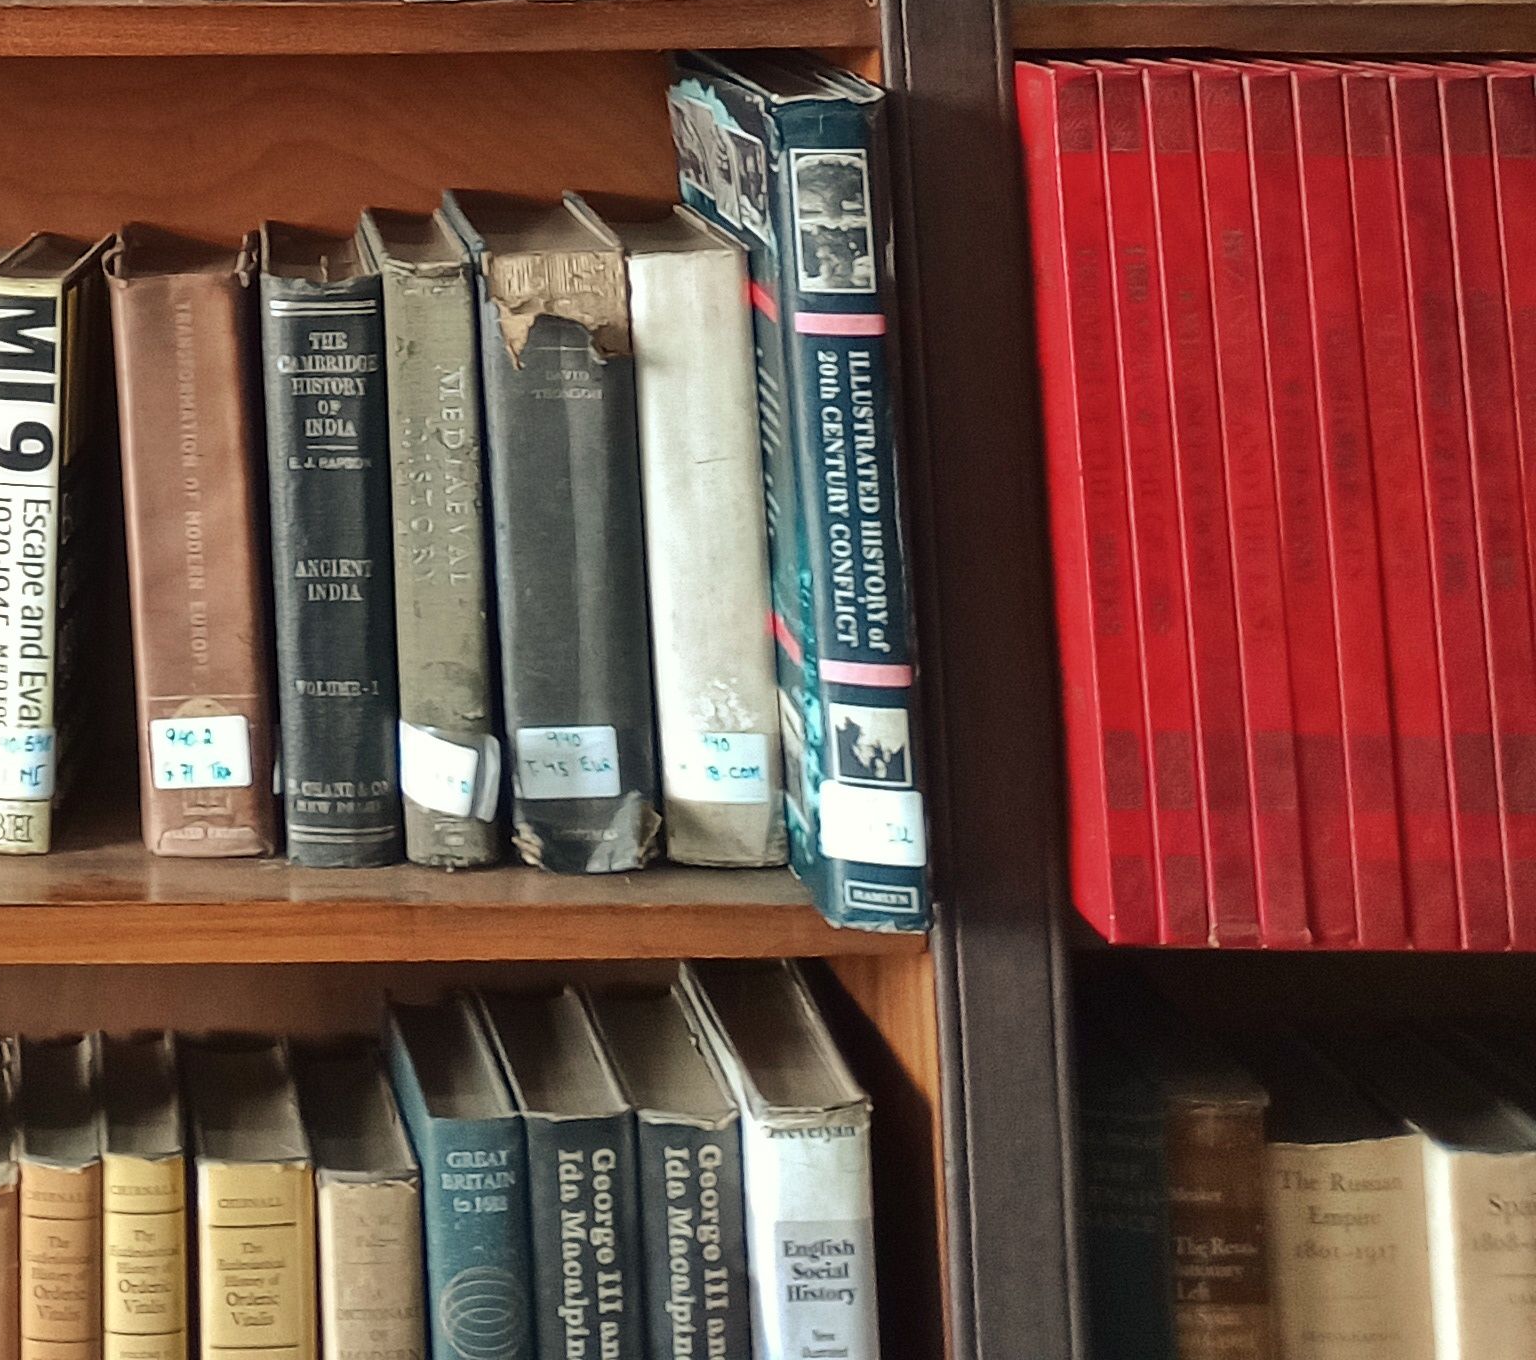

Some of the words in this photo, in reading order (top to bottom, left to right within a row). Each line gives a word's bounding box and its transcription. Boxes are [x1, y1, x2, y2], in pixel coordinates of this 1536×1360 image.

[308, 331, 348, 351] THE
[277, 353, 378, 373] CAMBRIDGE
[817, 350, 842, 400] 20th
[290, 376, 367, 398] HISTORY
[317, 399, 343, 417] OF
[304, 418, 358, 440] INDIA
[848, 350, 881, 515] ILLUSTRATED
[821, 406, 851, 518] CENTURY
[16, 497, 52, 597] Escape
[293, 559, 373, 579] ANCIENT
[861, 521, 889, 627] HISTORY
[307, 583, 363, 603] INDIA
[828, 522, 860, 648] CONFLICT
[18, 602, 50, 661] and
[868, 629, 892, 653] of
[447, 1150, 508, 1168] GREAT
[441, 1171, 517, 1190] BRITAIN
[591, 1147, 617, 1266] George
[782, 1239, 856, 1259] English
[791, 1261, 850, 1282] Social
[597, 1269, 623, 1313] III
[786, 1283, 856, 1306] History
